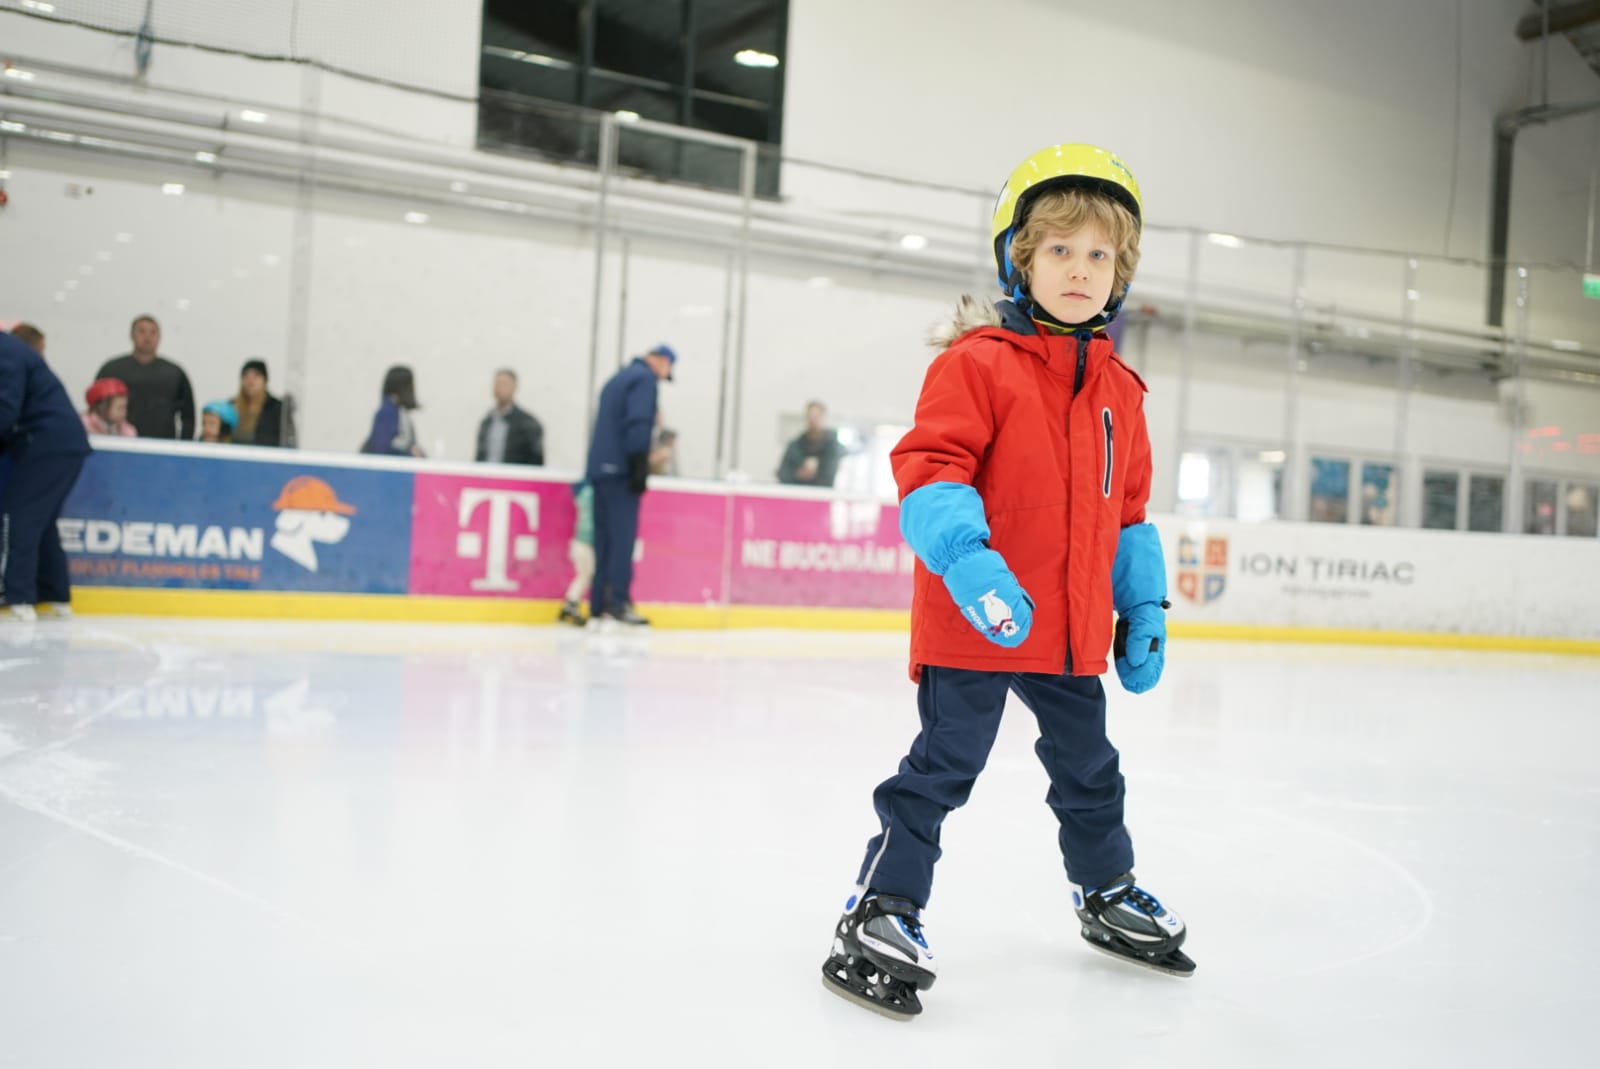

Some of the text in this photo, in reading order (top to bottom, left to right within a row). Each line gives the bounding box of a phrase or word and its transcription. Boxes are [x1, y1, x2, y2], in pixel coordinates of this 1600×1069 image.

[459, 488, 540, 592] T
[742, 539, 775, 569] NE
[1239, 552, 1298, 577] ION
